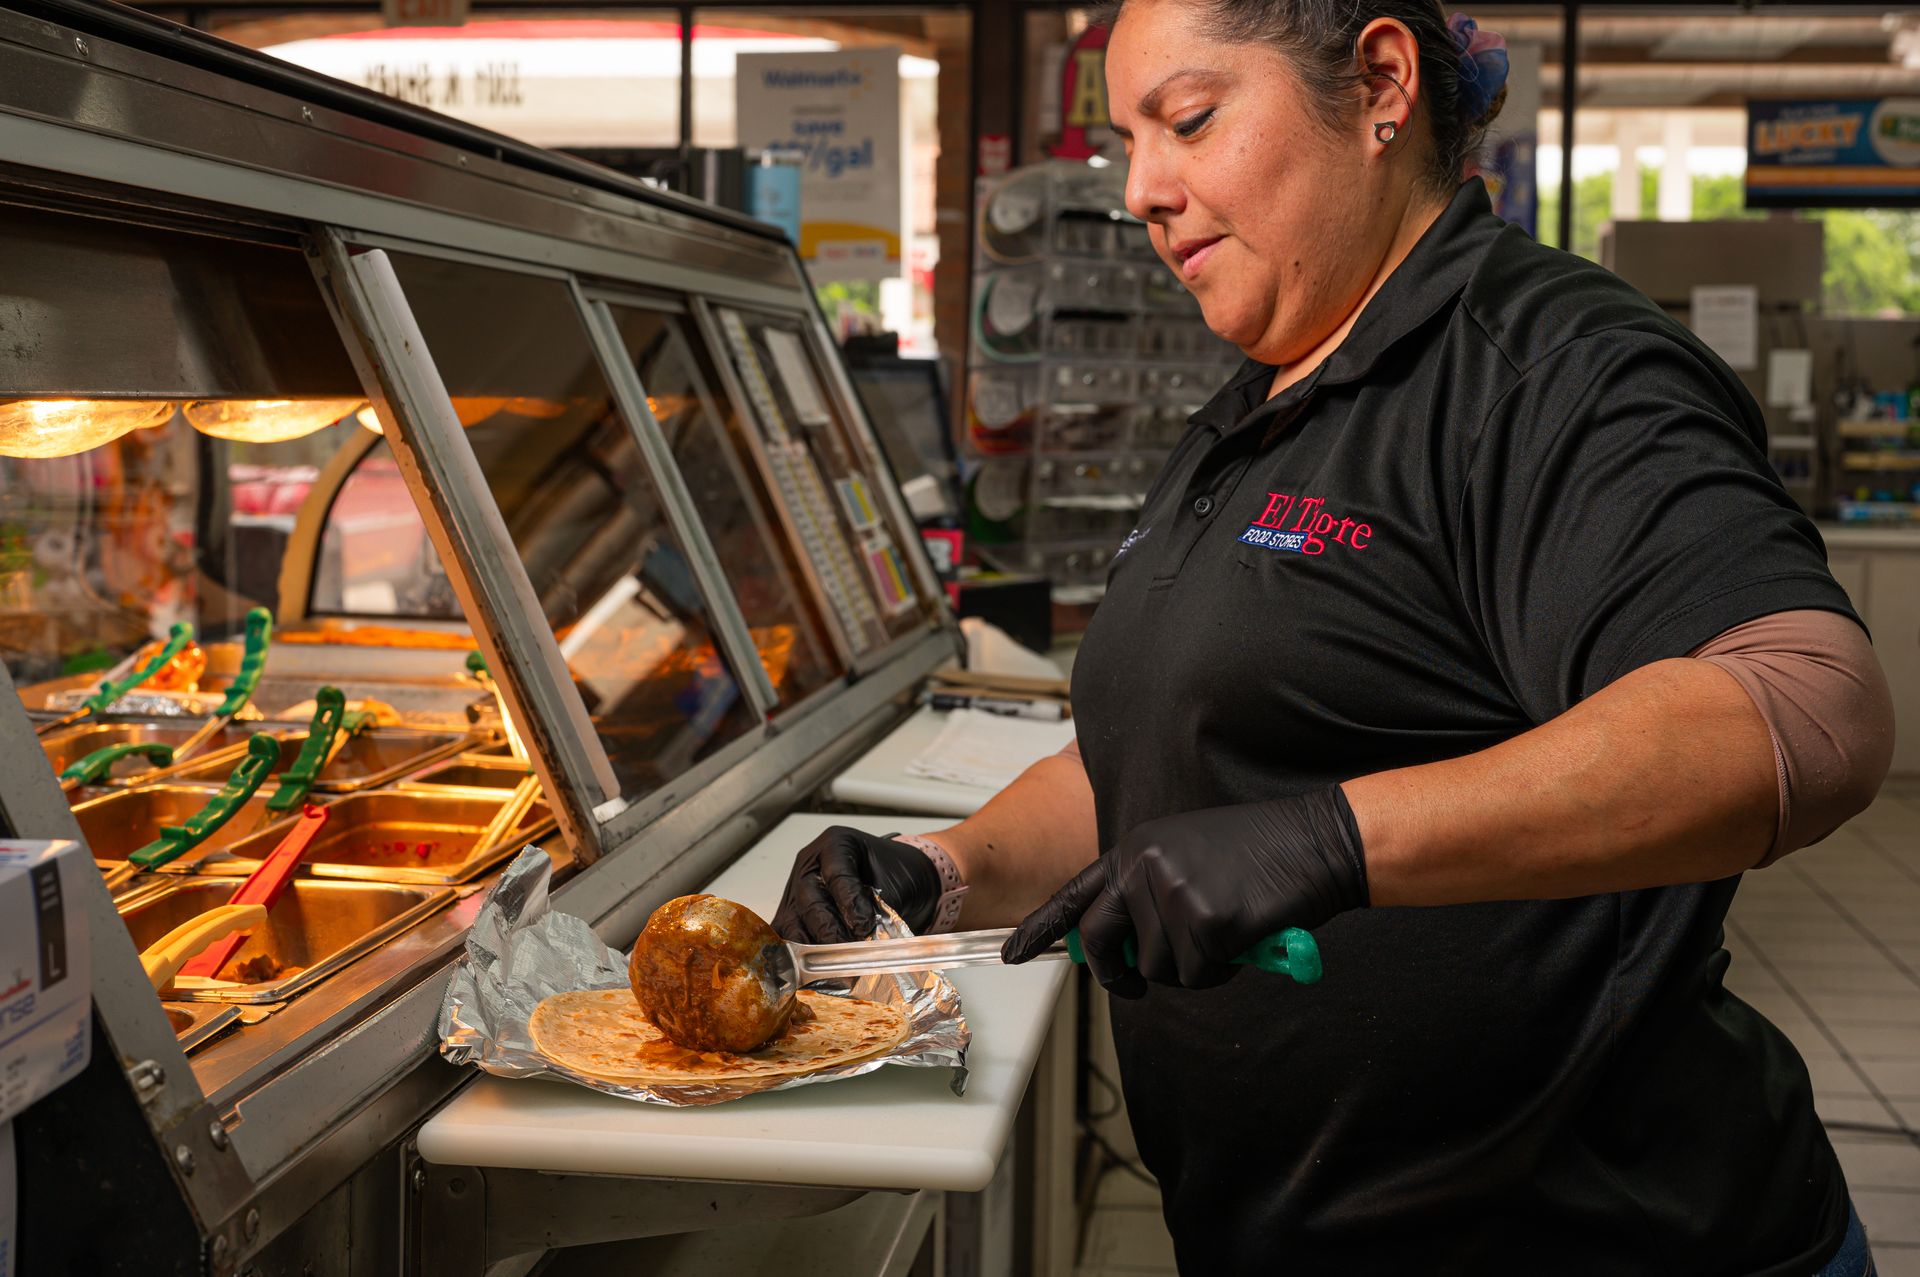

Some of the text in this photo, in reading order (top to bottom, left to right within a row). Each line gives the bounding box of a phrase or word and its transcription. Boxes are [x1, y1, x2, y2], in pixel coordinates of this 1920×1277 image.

[1242, 528, 1305, 549] FOOD STORES
[1251, 492, 1373, 555] El Tigre
